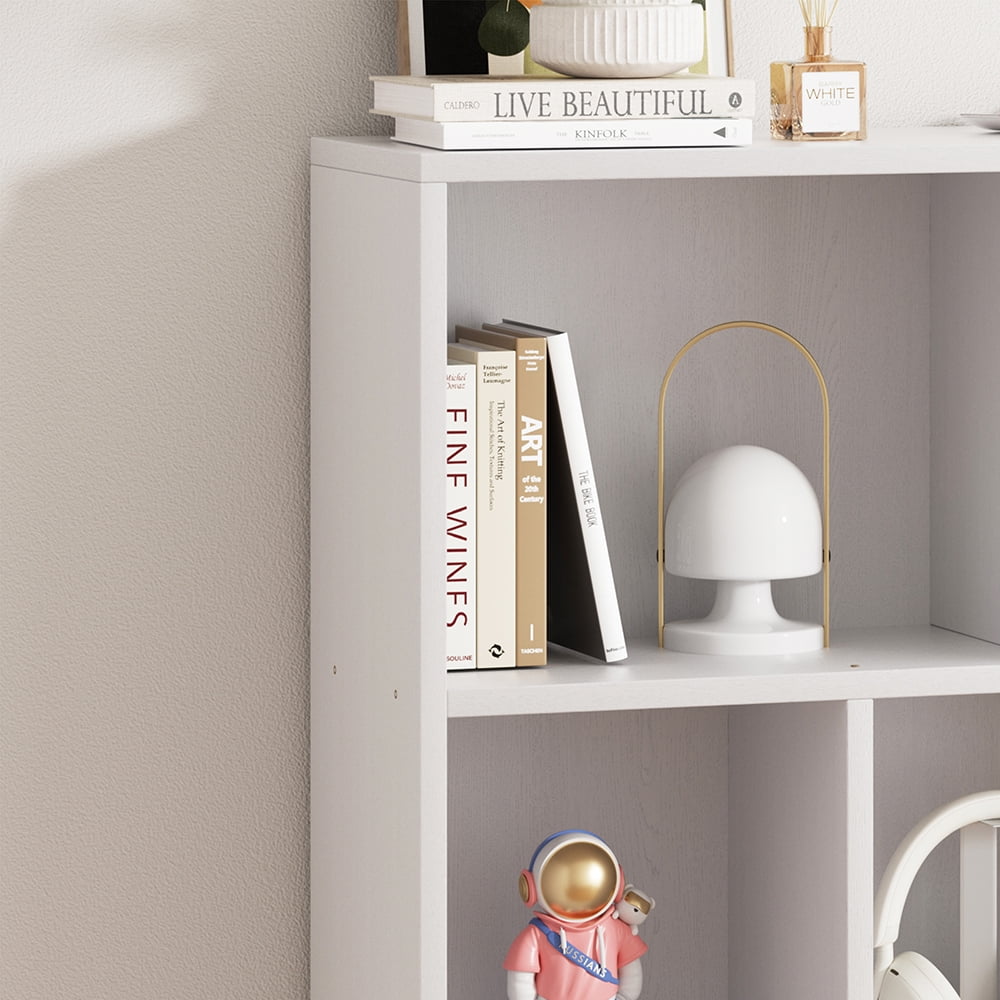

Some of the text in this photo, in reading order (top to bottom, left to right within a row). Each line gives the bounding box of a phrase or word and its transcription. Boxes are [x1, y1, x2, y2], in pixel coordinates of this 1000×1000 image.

[444, 101, 480, 110] CALDERO
[494, 89, 713, 118] LIVE BEAUTIFUL
[806, 87, 855, 99] WHITE
[575, 129, 628, 139] KINFOLK
[494, 400, 506, 481] The Art of Knitting
[521, 415, 543, 467] ART
[519, 496, 544, 504] Century
[578, 470, 598, 528] THE BIKE BOOK
[559, 943, 608, 978] USSIANS
